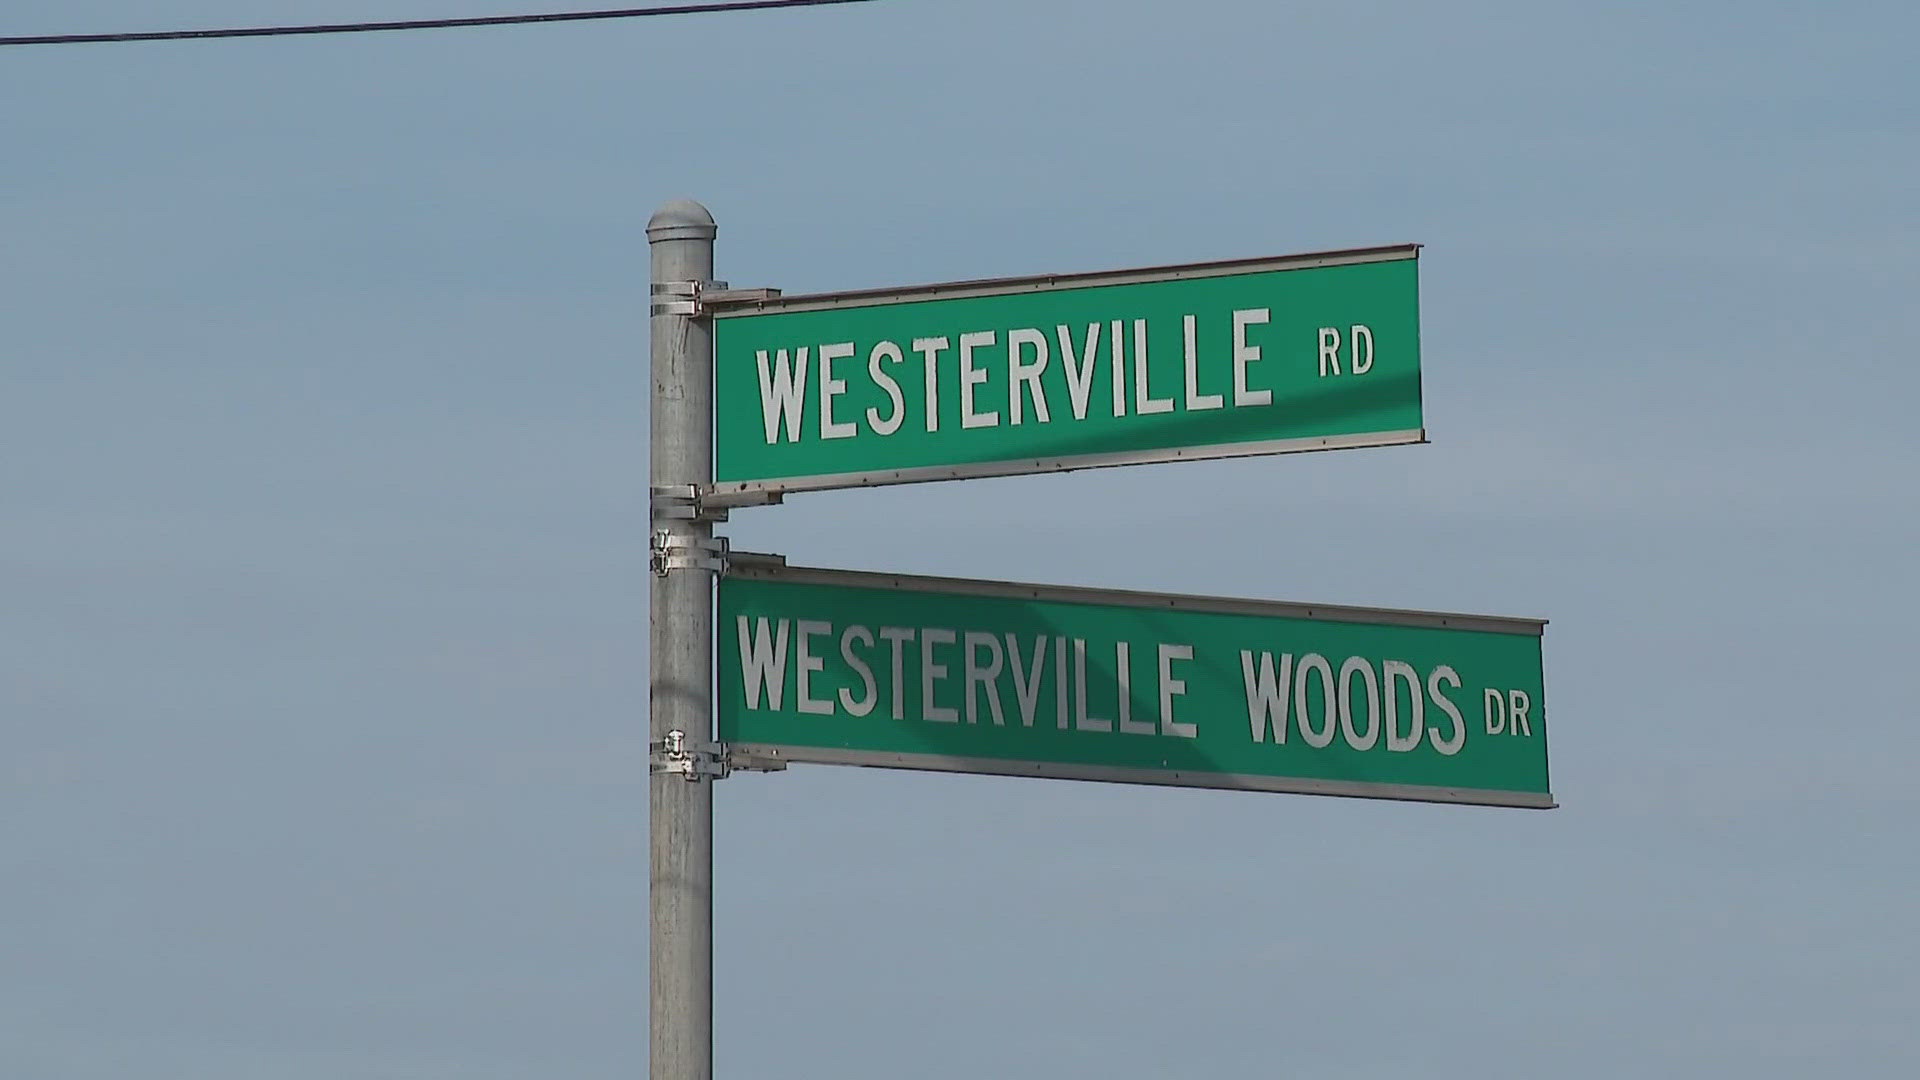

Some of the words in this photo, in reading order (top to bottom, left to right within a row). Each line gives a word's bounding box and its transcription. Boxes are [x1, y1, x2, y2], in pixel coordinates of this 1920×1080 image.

[756, 308, 1273, 445] WESTERVILLE
[1318, 324, 1375, 377] RD
[736, 614, 1198, 739] WESTERVILLE
[1240, 650, 1467, 756] WOODS
[1483, 687, 1532, 737] DR
